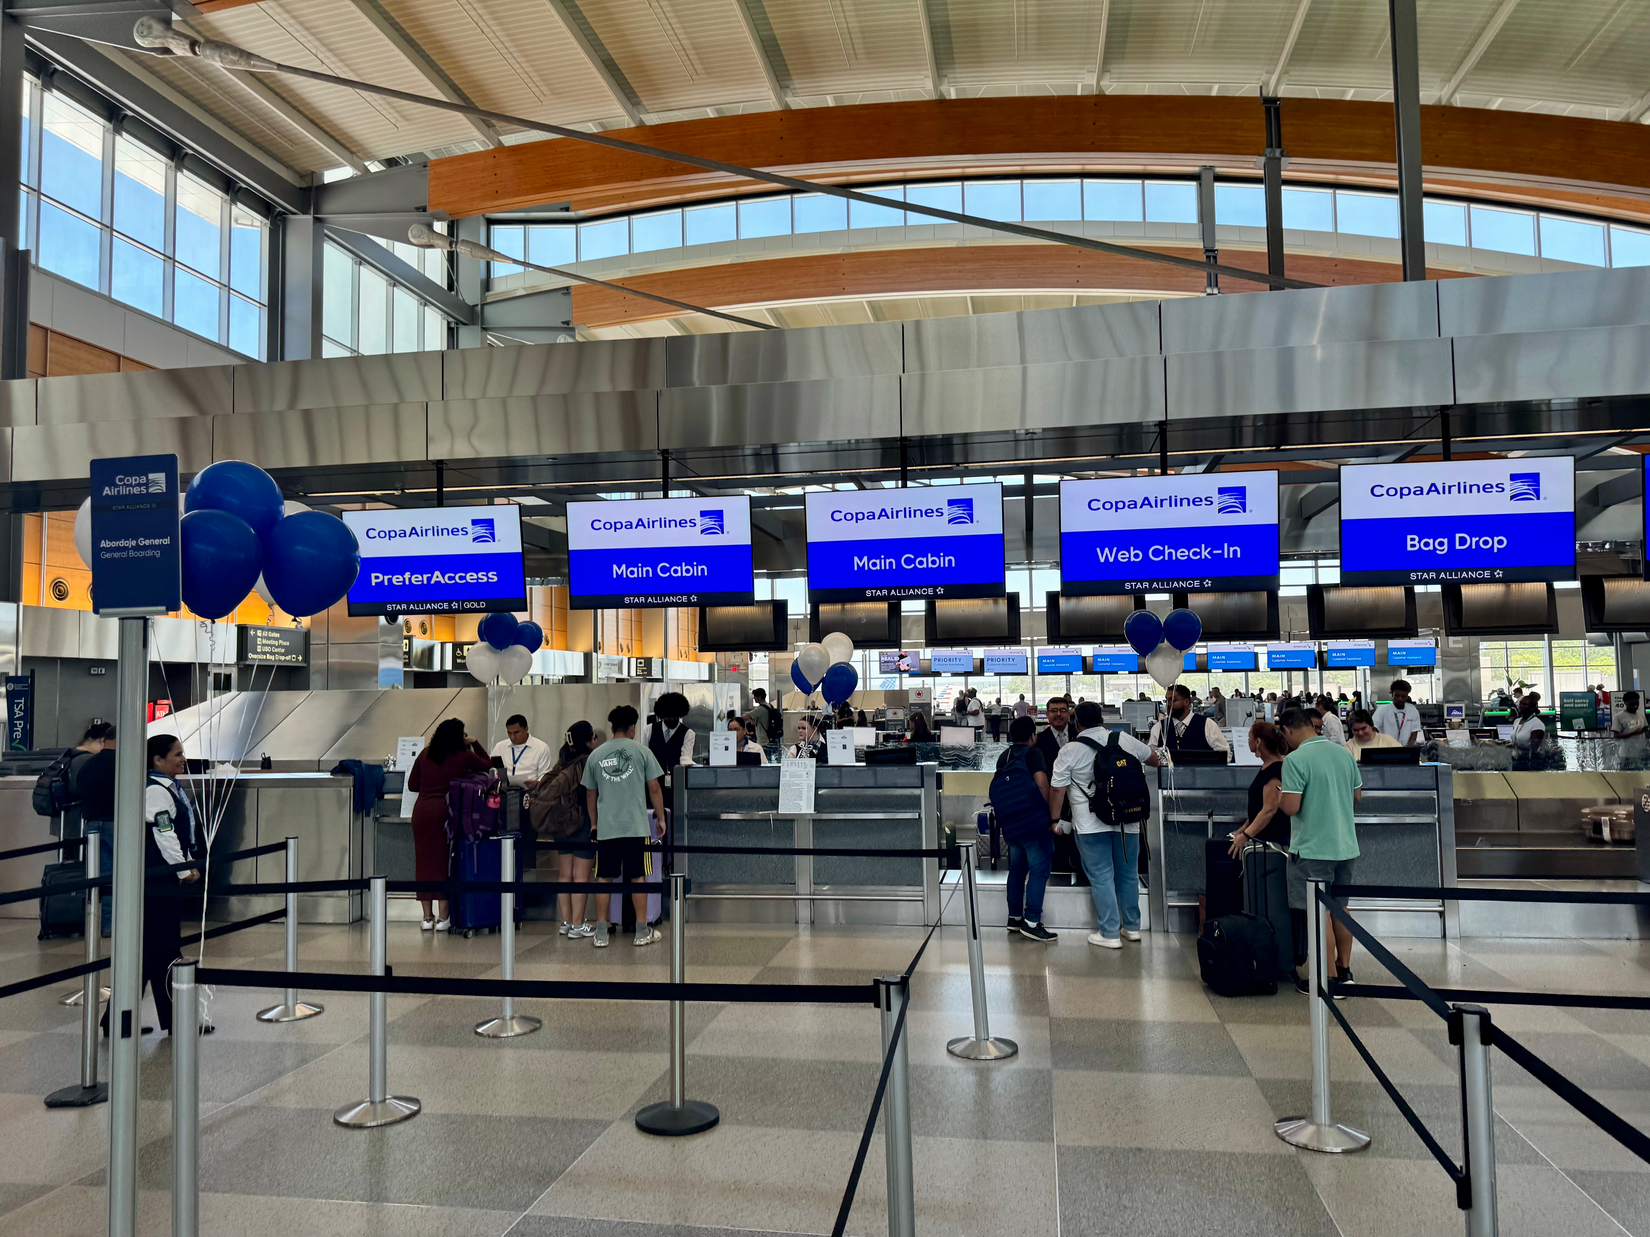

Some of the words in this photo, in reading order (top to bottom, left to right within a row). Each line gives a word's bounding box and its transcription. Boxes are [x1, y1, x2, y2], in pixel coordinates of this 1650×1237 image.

[116, 475, 147, 486] Copa
[102, 485, 147, 496] Airlines
[1370, 481, 1506, 499] CopaAirlines
[1087, 495, 1214, 513] CopaAirlines
[830, 506, 944, 524] CopaAirlines
[590, 517, 697, 533] CopaAirlines
[365, 525, 469, 541] CopaAirlines
[100, 538, 136, 548] Abordaje
[138, 536, 171, 546] General
[1406, 534, 1449, 555] Bag
[1455, 533, 1508, 553] Drop
[100, 550, 128, 559] General
[128, 549, 161, 558] Boarding
[1096, 546, 1143, 563] Web
[1148, 543, 1241, 562] Check-In
[853, 555, 896, 571] Main
[900, 553, 956, 569] Cabin
[612, 563, 653, 579] Main
[657, 561, 708, 578] Cabin
[1409, 572, 1437, 581] STAR
[1439, 570, 1491, 579] ALLIANCE
[370, 571, 498, 587] PreferAccess
[1124, 582, 1150, 590] STAR
[1151, 580, 1201, 589] ALLIANCE
[865, 589, 888, 597] STAR
[890, 587, 934, 596] ALLIANCE
[386, 603, 408, 611] STAR
[409, 602, 449, 610] ALLIANCE
[463, 601, 486, 609] GOLD
[624, 596, 646, 604] STAR
[647, 595, 688, 604] ALLIANCE
[248, 652, 266, 660] Oversize
[13, 697, 25, 719] TSA
[13, 720, 24, 739] Pre
[598, 758, 618, 768] VANS
[1116, 759, 1127, 767] CAT
